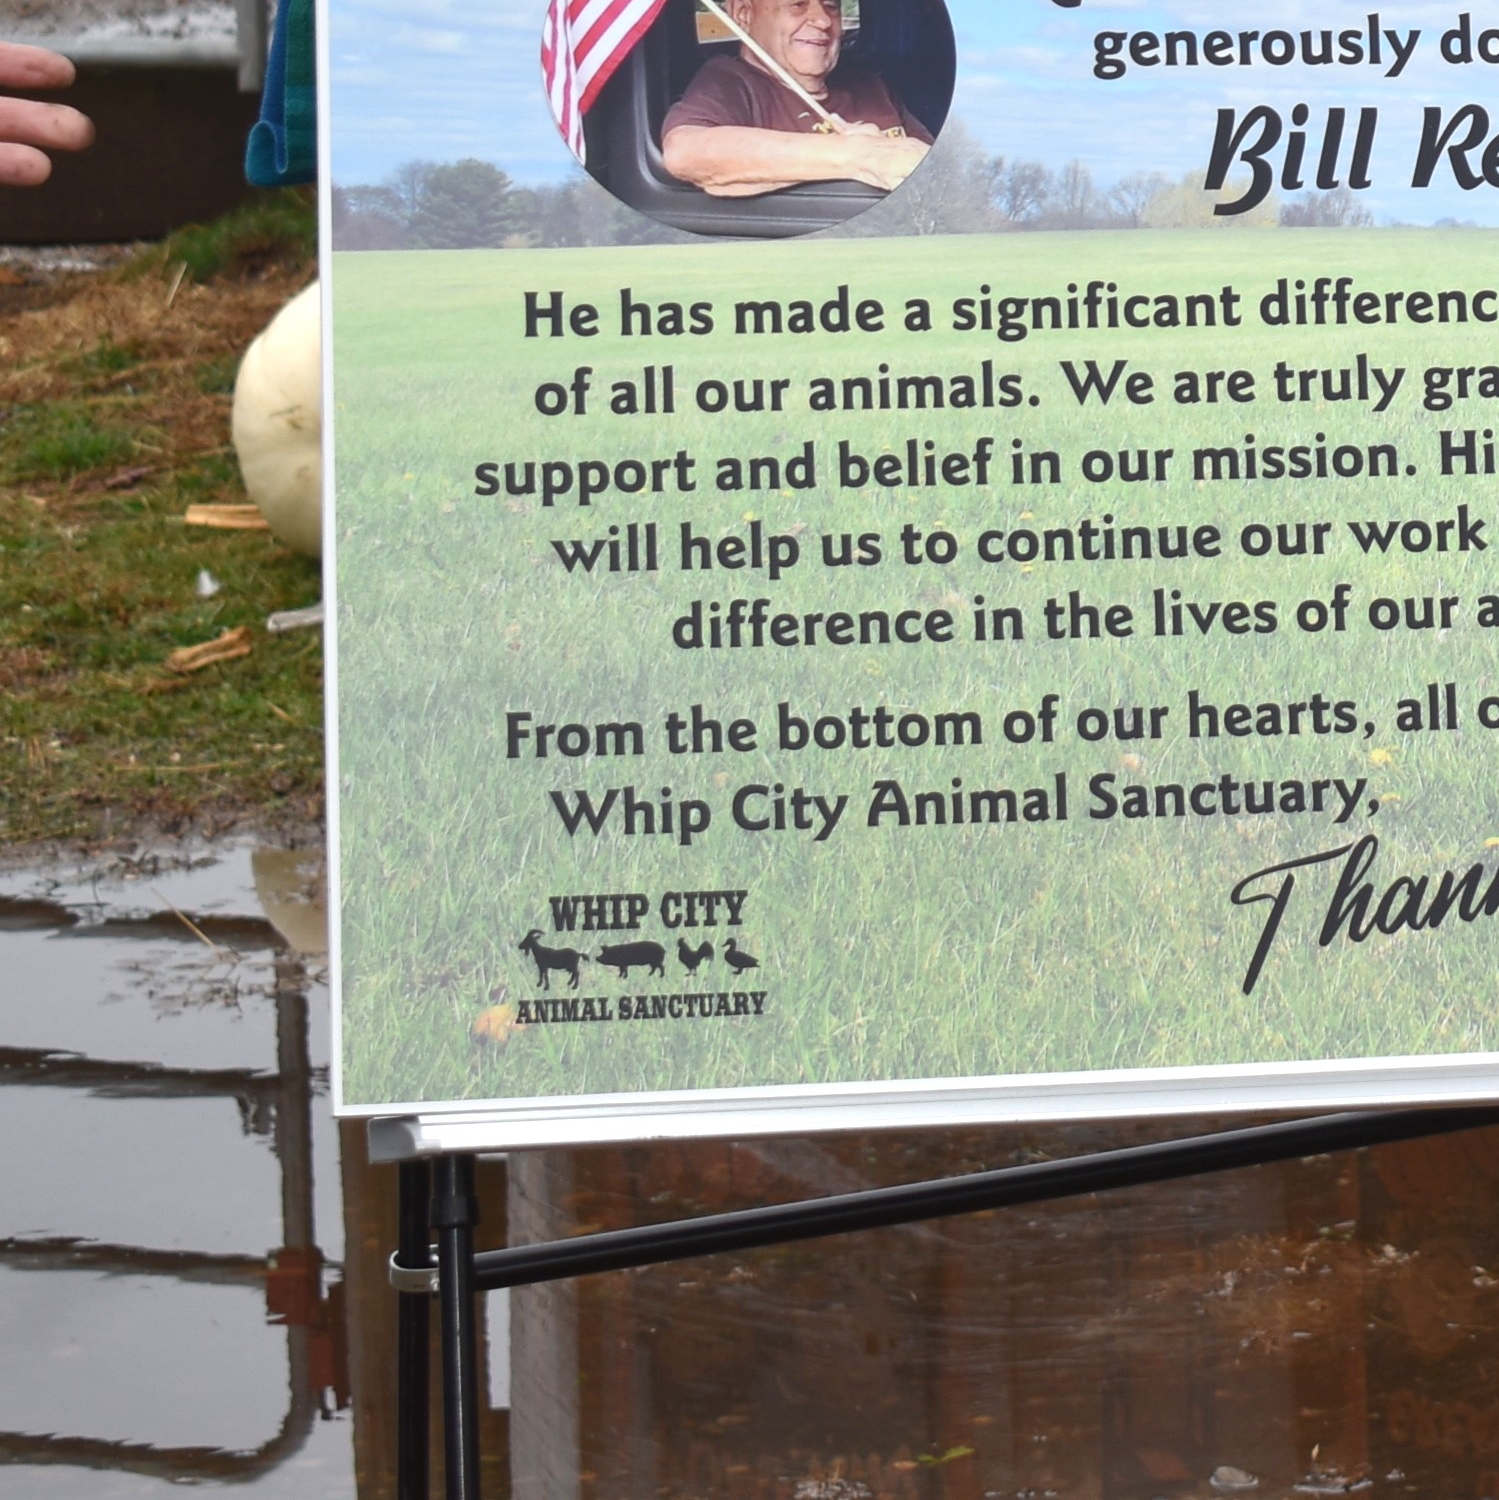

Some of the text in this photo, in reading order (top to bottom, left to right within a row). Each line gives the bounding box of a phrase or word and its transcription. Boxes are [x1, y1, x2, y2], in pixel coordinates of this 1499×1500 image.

[1094, 14, 1420, 79] generously
[1205, 104, 1376, 215] Bill
[525, 292, 598, 336] He
[621, 289, 713, 335] has
[736, 286, 883, 333] made
[905, 300, 930, 331] a
[953, 282, 1242, 341] significant
[536, 367, 592, 415] of
[611, 366, 673, 414] all
[697, 380, 789, 412] our
[810, 361, 1039, 410] animals.
[1061, 361, 1153, 404] We
[1174, 371, 1254, 403] are
[1274, 354, 1405, 411] truly
[475, 451, 695, 506] support
[717, 442, 815, 490] and
[839, 438, 993, 487] belief
[1013, 439, 1060, 483] in
[1083, 450, 1173, 482] our
[1194, 433, 1415, 480] mission.
[551, 523, 657, 572] will
[681, 521, 798, 580] help
[822, 534, 881, 566] us
[901, 525, 957, 564] to
[978, 514, 1220, 562] continue
[1241, 523, 1331, 556] our
[1348, 505, 1487, 553] work
[673, 599, 953, 649] difference
[975, 596, 1023, 640] in
[1044, 591, 1133, 639] the
[1154, 589, 1277, 635] lives
[1297, 584, 1351, 632] of
[1369, 597, 1458, 630] our
[507, 713, 643, 758] From
[666, 705, 756, 753] the
[778, 703, 982, 750] bottom
[1004, 695, 1059, 743] of
[1077, 707, 1168, 741] our
[1189, 691, 1374, 739] hearts,
[1397, 683, 1457, 731] all
[550, 773, 1379, 845] Whip City Animal Sanctuary,
[549, 890, 747, 931] WHIP CITY
[516, 992, 766, 1023] ANIMAL SANCTUARY
